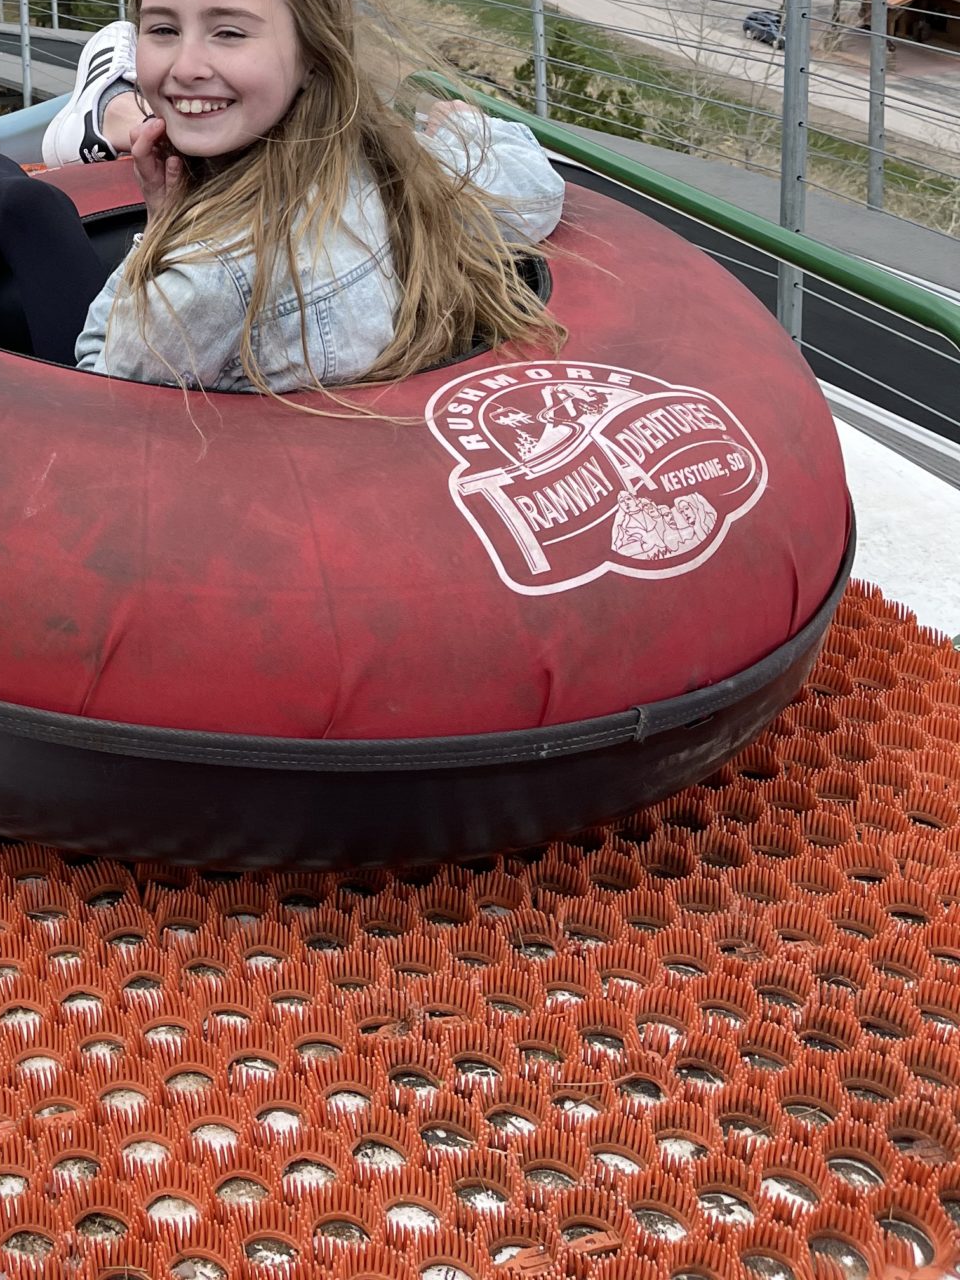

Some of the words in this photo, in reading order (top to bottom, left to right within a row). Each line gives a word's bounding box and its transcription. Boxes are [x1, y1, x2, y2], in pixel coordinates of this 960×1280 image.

[447, 367, 633, 451] RUSHMORE
[457, 456, 614, 575] TRAMWAY
[591, 403, 727, 495] ADVENTURES
[660, 461, 730, 493] KEYSTONE,
[728, 453, 745, 472] SD
